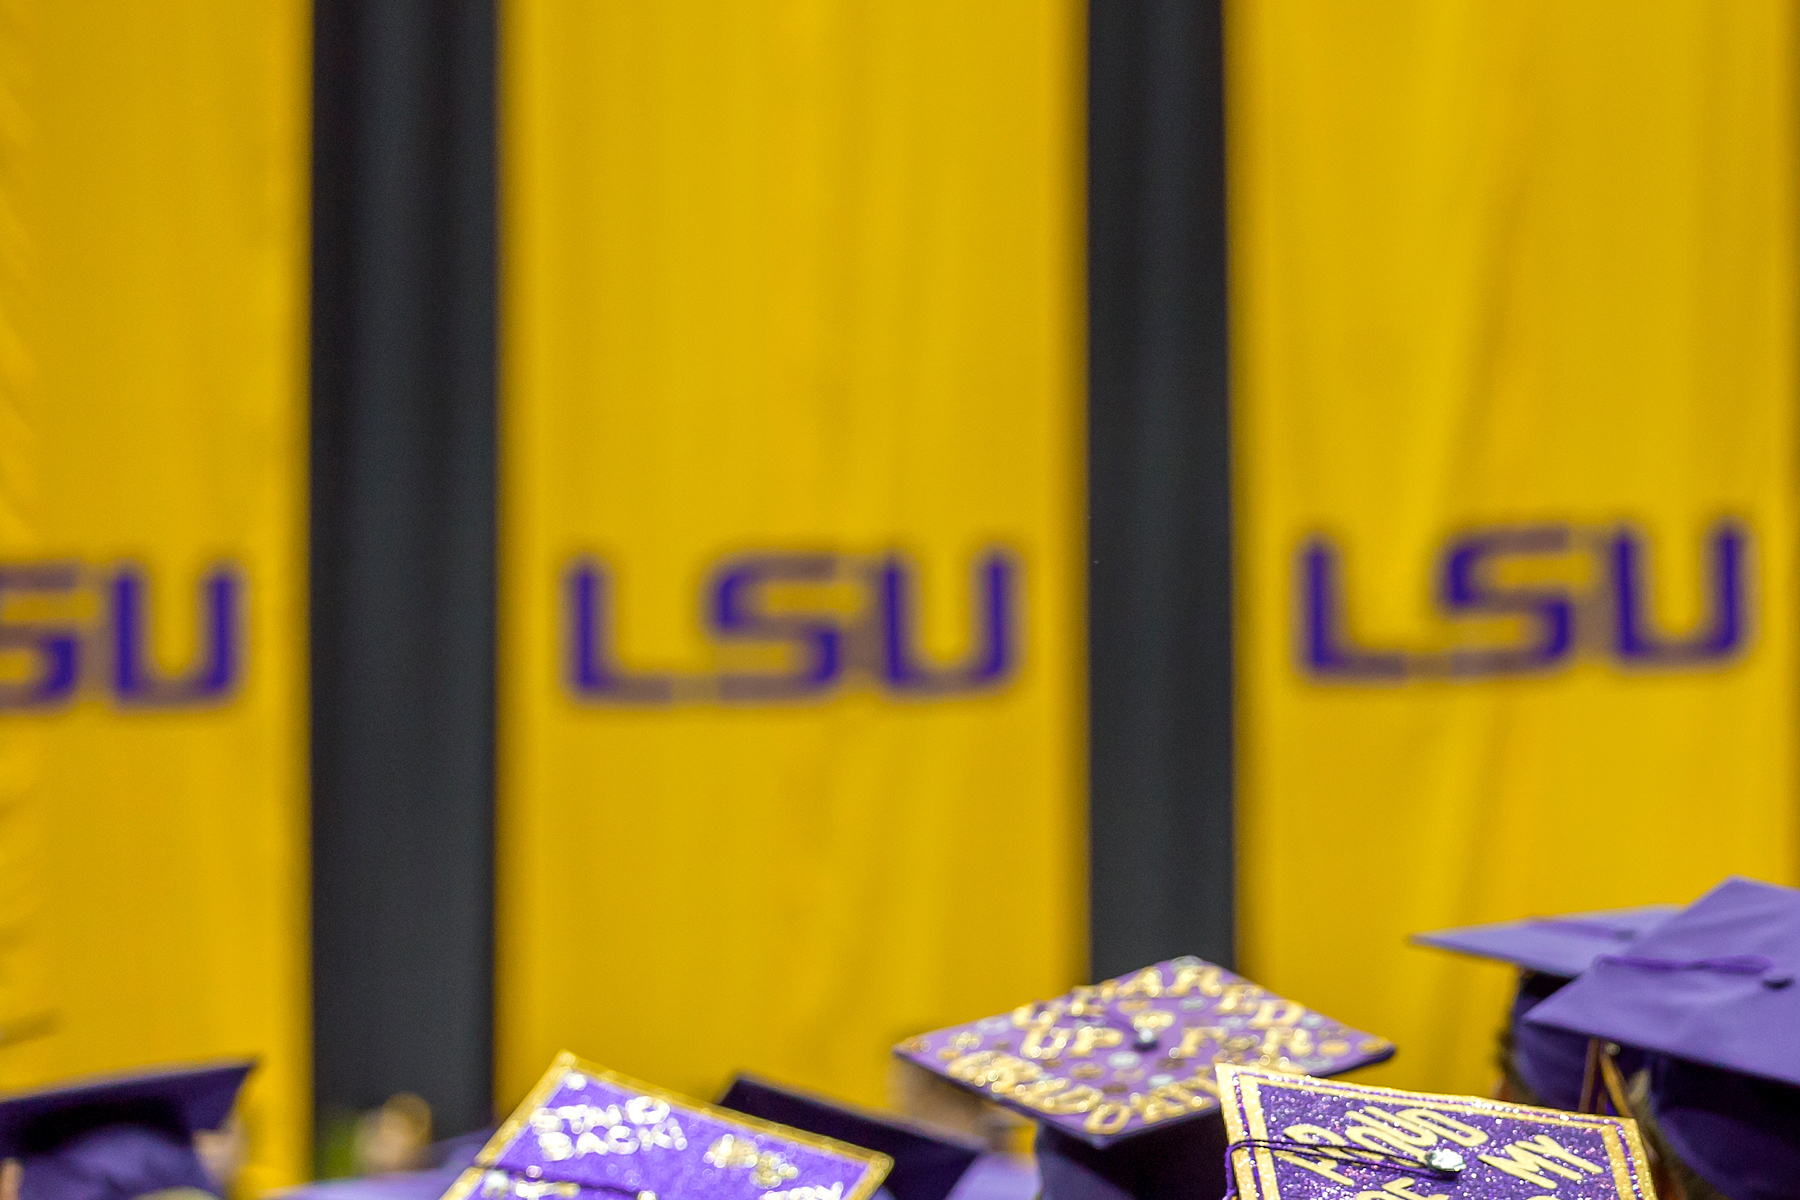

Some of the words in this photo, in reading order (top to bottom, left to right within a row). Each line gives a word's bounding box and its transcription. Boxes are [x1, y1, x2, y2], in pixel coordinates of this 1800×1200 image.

[562, 548, 1020, 708] LSU
[1297, 515, 1752, 686] LSU
[1274, 1104, 1490, 1188] PROUD
[1477, 1134, 1604, 1190] MY
